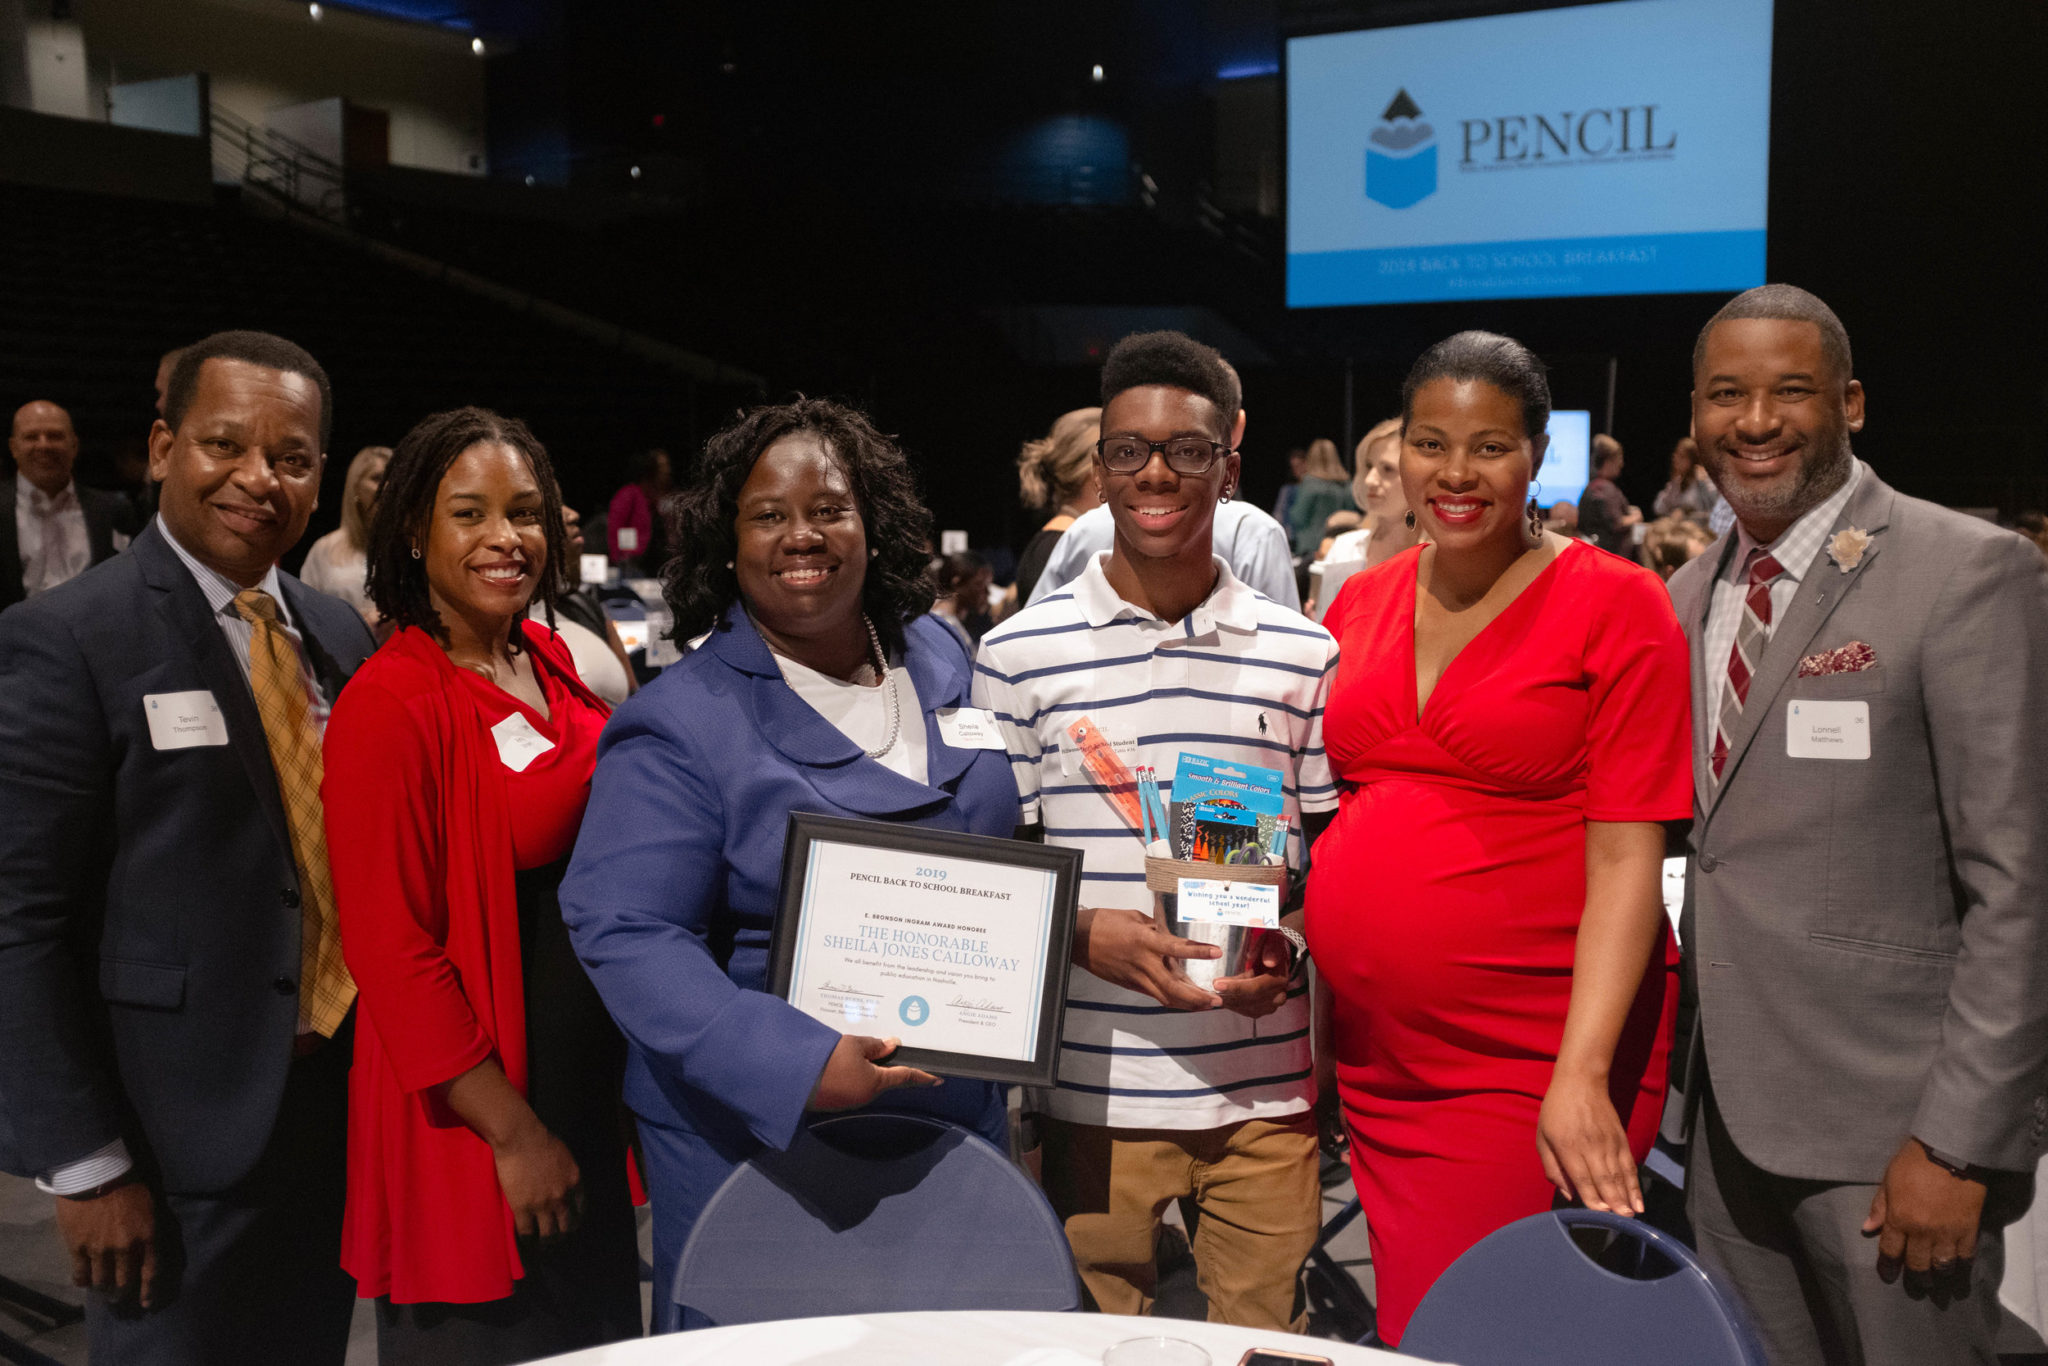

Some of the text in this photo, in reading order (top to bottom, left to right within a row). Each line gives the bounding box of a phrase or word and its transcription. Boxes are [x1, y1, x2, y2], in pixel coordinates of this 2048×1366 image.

[1458, 105, 1678, 164] PENCIL
[1419, 256, 1461, 272] BACK
[1466, 254, 1487, 270] TO
[1492, 252, 1557, 268] SCHOOL
[1564, 246, 1657, 265] BREAKFAST
[1112, 739, 1135, 747] Student
[1187, 772, 1272, 794] Smooth & Brilliant Colors
[1209, 788, 1239, 798] COLORS
[915, 867, 948, 881] 2019
[850, 872, 1012, 901] PENCIL BACK TO SCHOOL BREAKFAST
[1187, 891, 1213, 900] Wishing
[1235, 895, 1271, 904] wonderful
[872, 914, 903, 922] BRONSON
[904, 918, 931, 926] INGRAM
[932, 922, 956, 930] AWARD
[957, 925, 987, 934] HONOREE
[858, 925, 989, 953] THE HONORABLE
[823, 935, 1020, 972] SHEILA JONES CALLOWAY
[862, 959, 881, 967] benefit
[907, 965, 935, 975] leadership
[974, 974, 989, 982] bring
[898, 973, 926, 981] education
